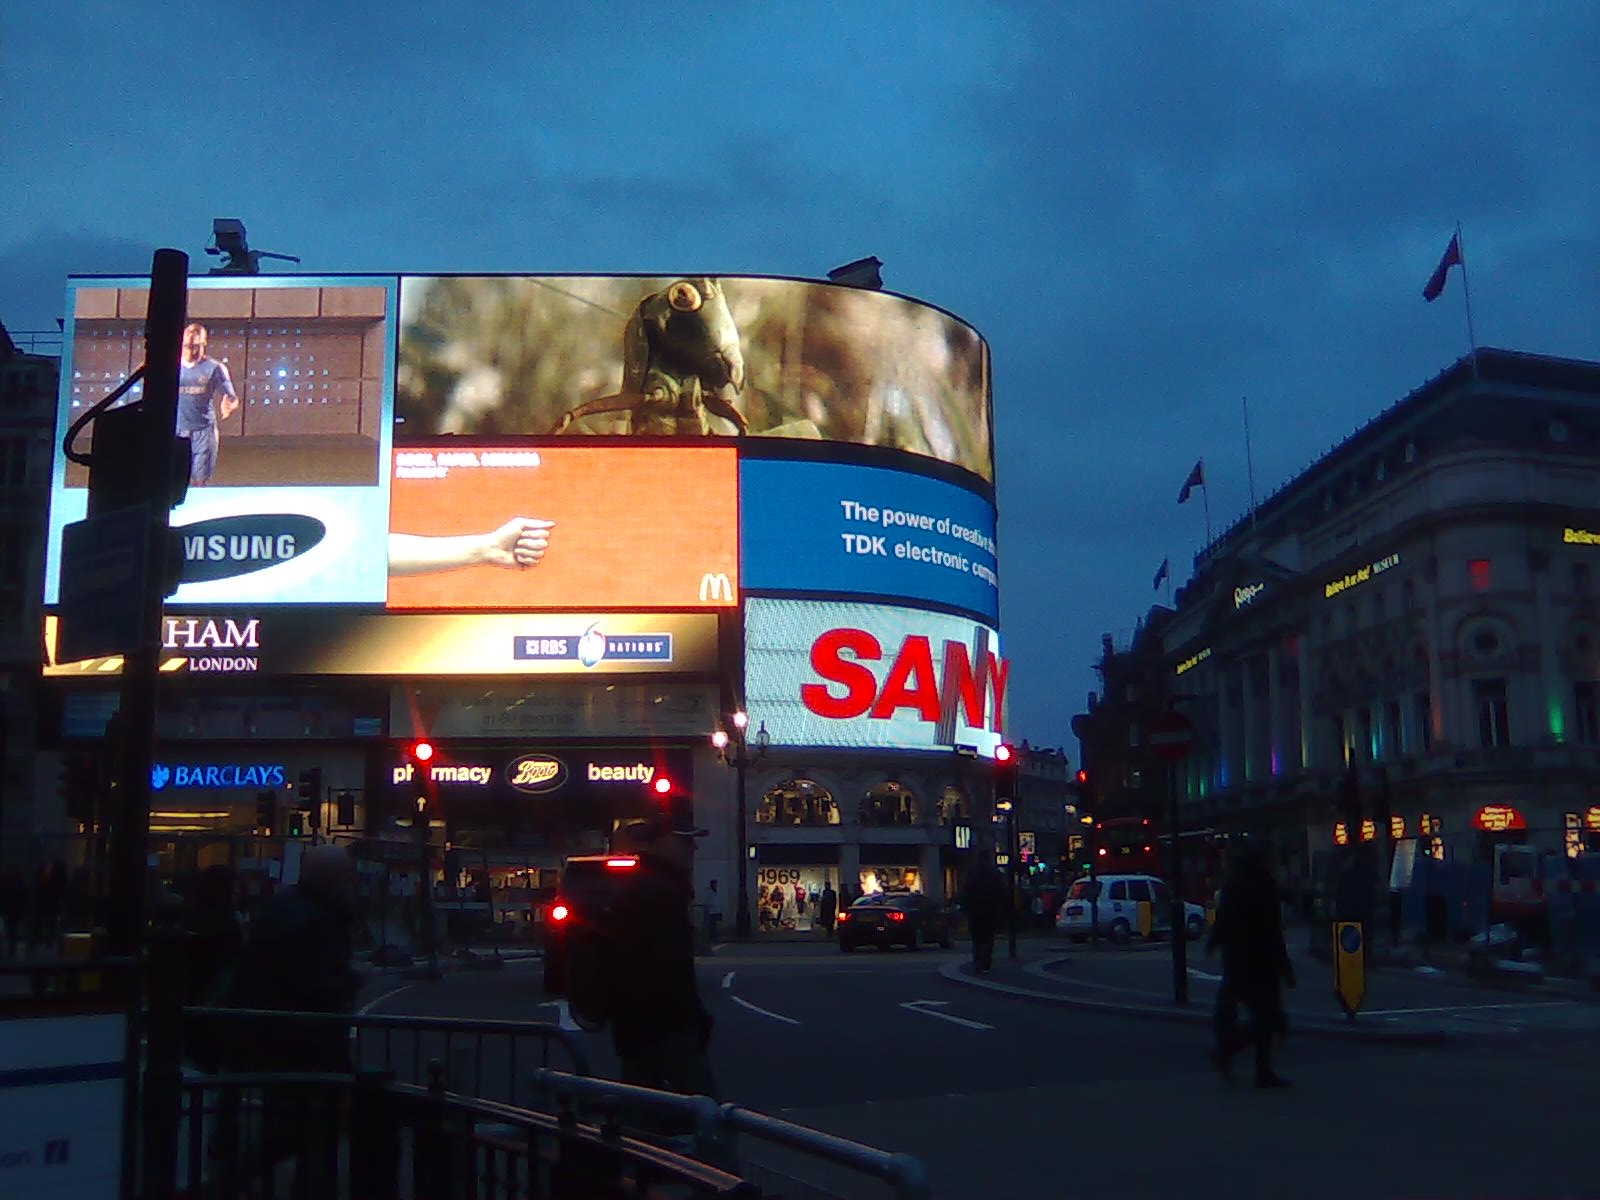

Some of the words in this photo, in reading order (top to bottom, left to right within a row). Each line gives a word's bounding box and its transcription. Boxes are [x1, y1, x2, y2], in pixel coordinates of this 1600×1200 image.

[840, 500, 880, 522] The
[882, 508, 936, 531] power
[936, 517, 951, 535] of
[184, 534, 296, 561] MSUNG
[841, 533, 888, 555] TDK
[894, 540, 970, 572] electronic
[189, 657, 259, 672] LONDON
[174, 765, 285, 786] BARCLAYS
[393, 763, 492, 785] phrmacy
[588, 762, 655, 784] beauty
